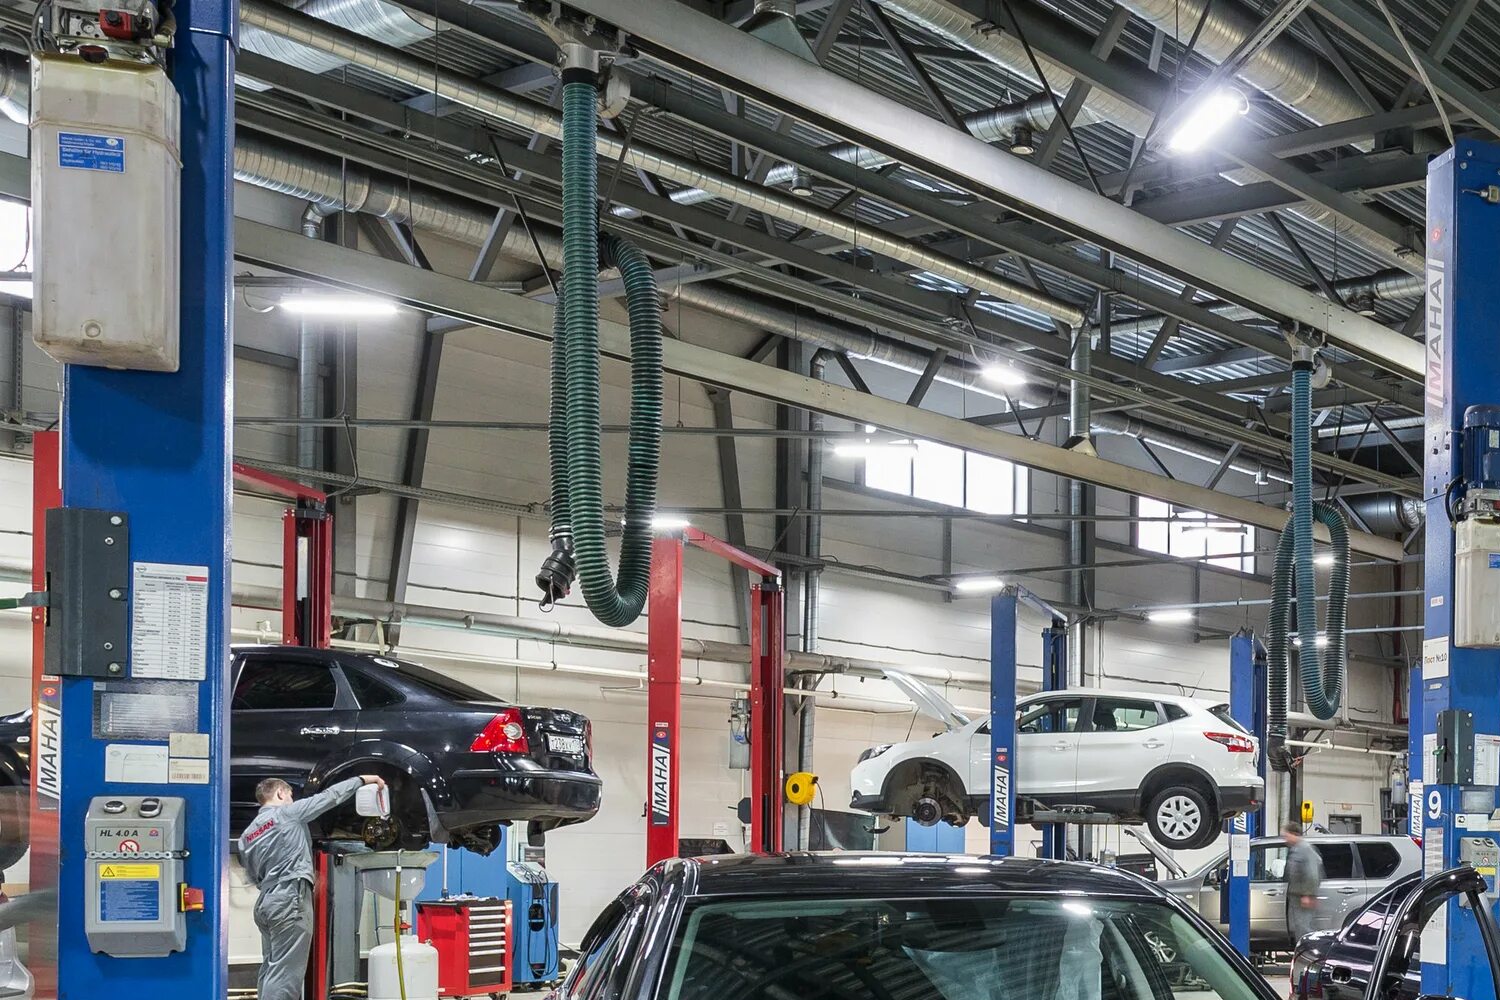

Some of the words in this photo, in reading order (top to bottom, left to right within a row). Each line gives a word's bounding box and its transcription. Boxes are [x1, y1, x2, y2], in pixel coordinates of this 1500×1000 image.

[1429, 278, 1442, 391] MAHA
[41, 719, 57, 788] MAHA
[655, 755, 667, 808] MAHA
[996, 775, 1007, 819] MAHA
[1428, 790, 1441, 819] 9
[116, 829, 130, 837] 4.0
[246, 819, 274, 843] NISSAN
